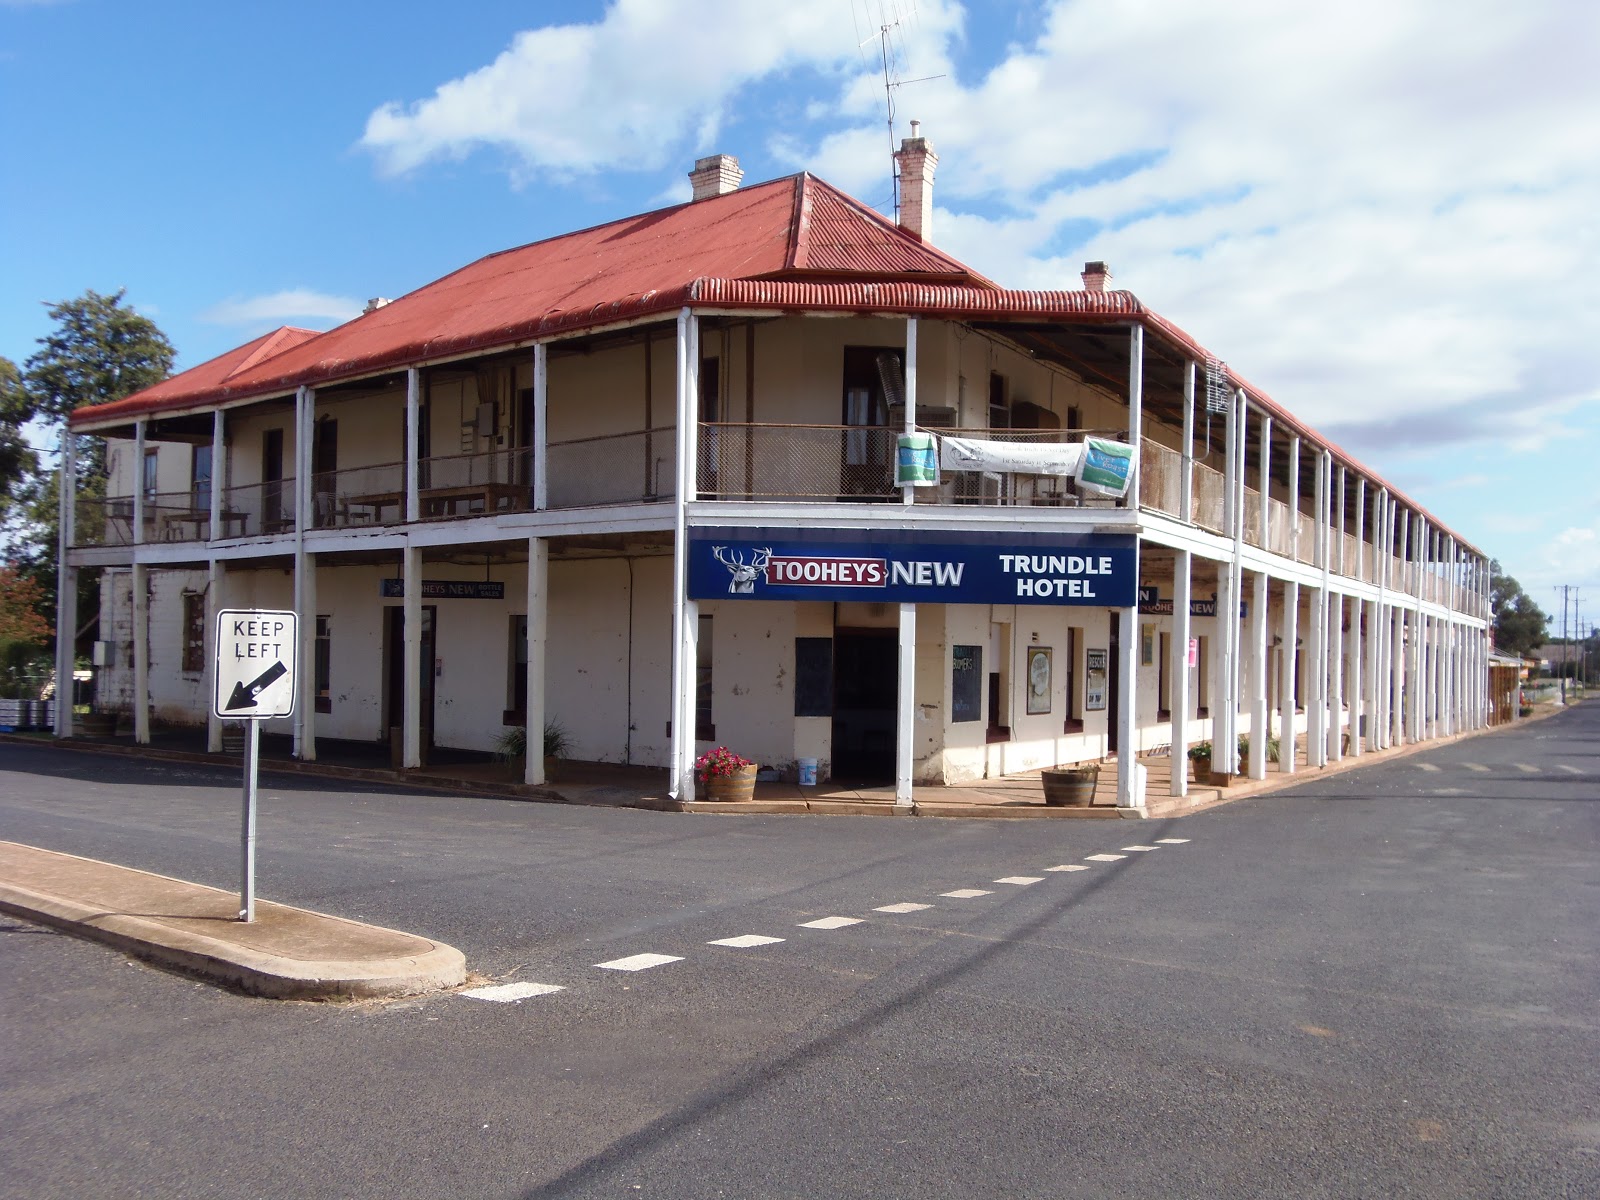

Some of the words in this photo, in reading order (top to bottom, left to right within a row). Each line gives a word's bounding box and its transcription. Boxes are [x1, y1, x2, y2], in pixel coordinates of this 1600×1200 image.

[772, 560, 882, 582] TOOHEYS
[891, 561, 965, 586] NEW
[1000, 555, 1113, 575] TRUNDLE
[449, 584, 475, 595] NEW
[1016, 579, 1096, 598] HOTEL
[234, 621, 284, 637] KEEP
[236, 643, 281, 658] LEFT
